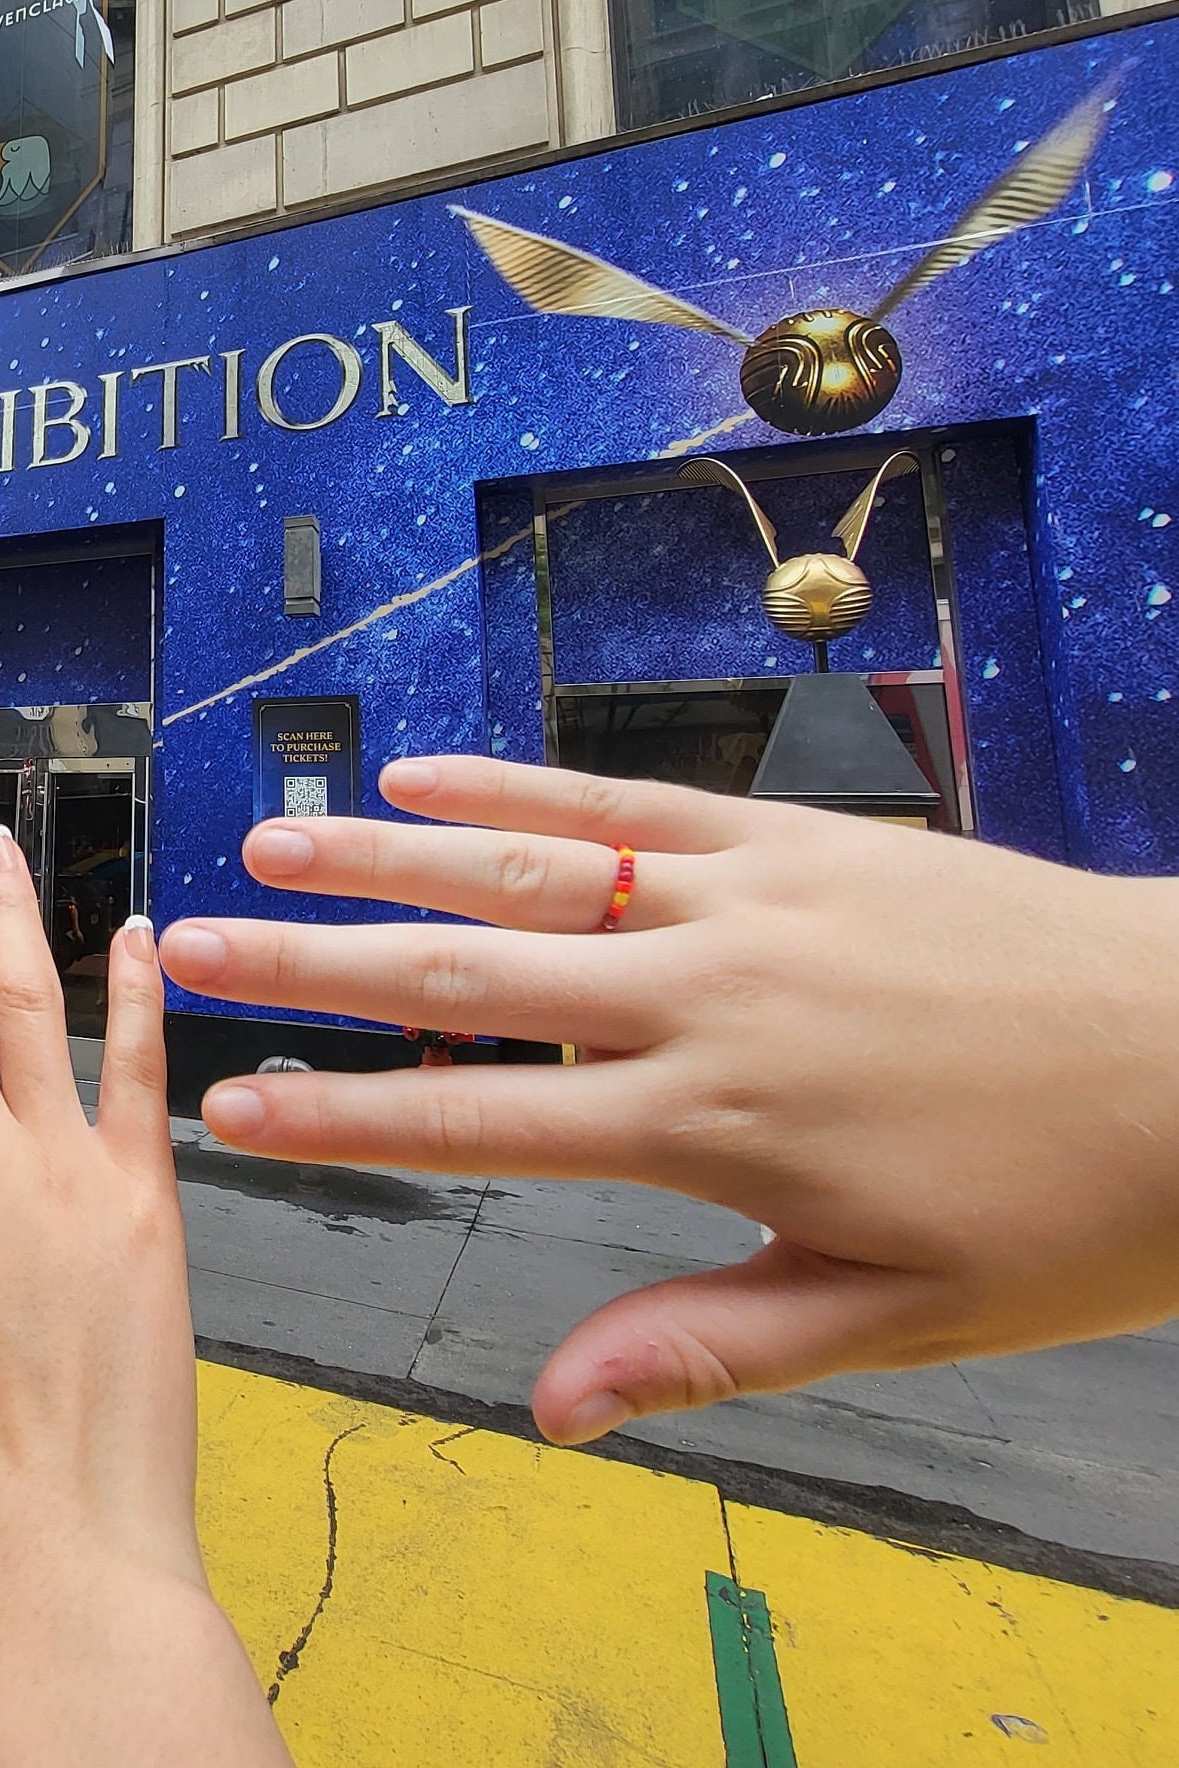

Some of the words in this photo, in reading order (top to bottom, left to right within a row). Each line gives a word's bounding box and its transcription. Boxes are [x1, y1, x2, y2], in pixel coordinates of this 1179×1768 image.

[277, 732, 304, 741] SCAN
[306, 732, 332, 741] HERE
[270, 744, 285, 752] TO
[287, 743, 342, 752] PURCHASE
[282, 754, 328, 762] TICKETS!
